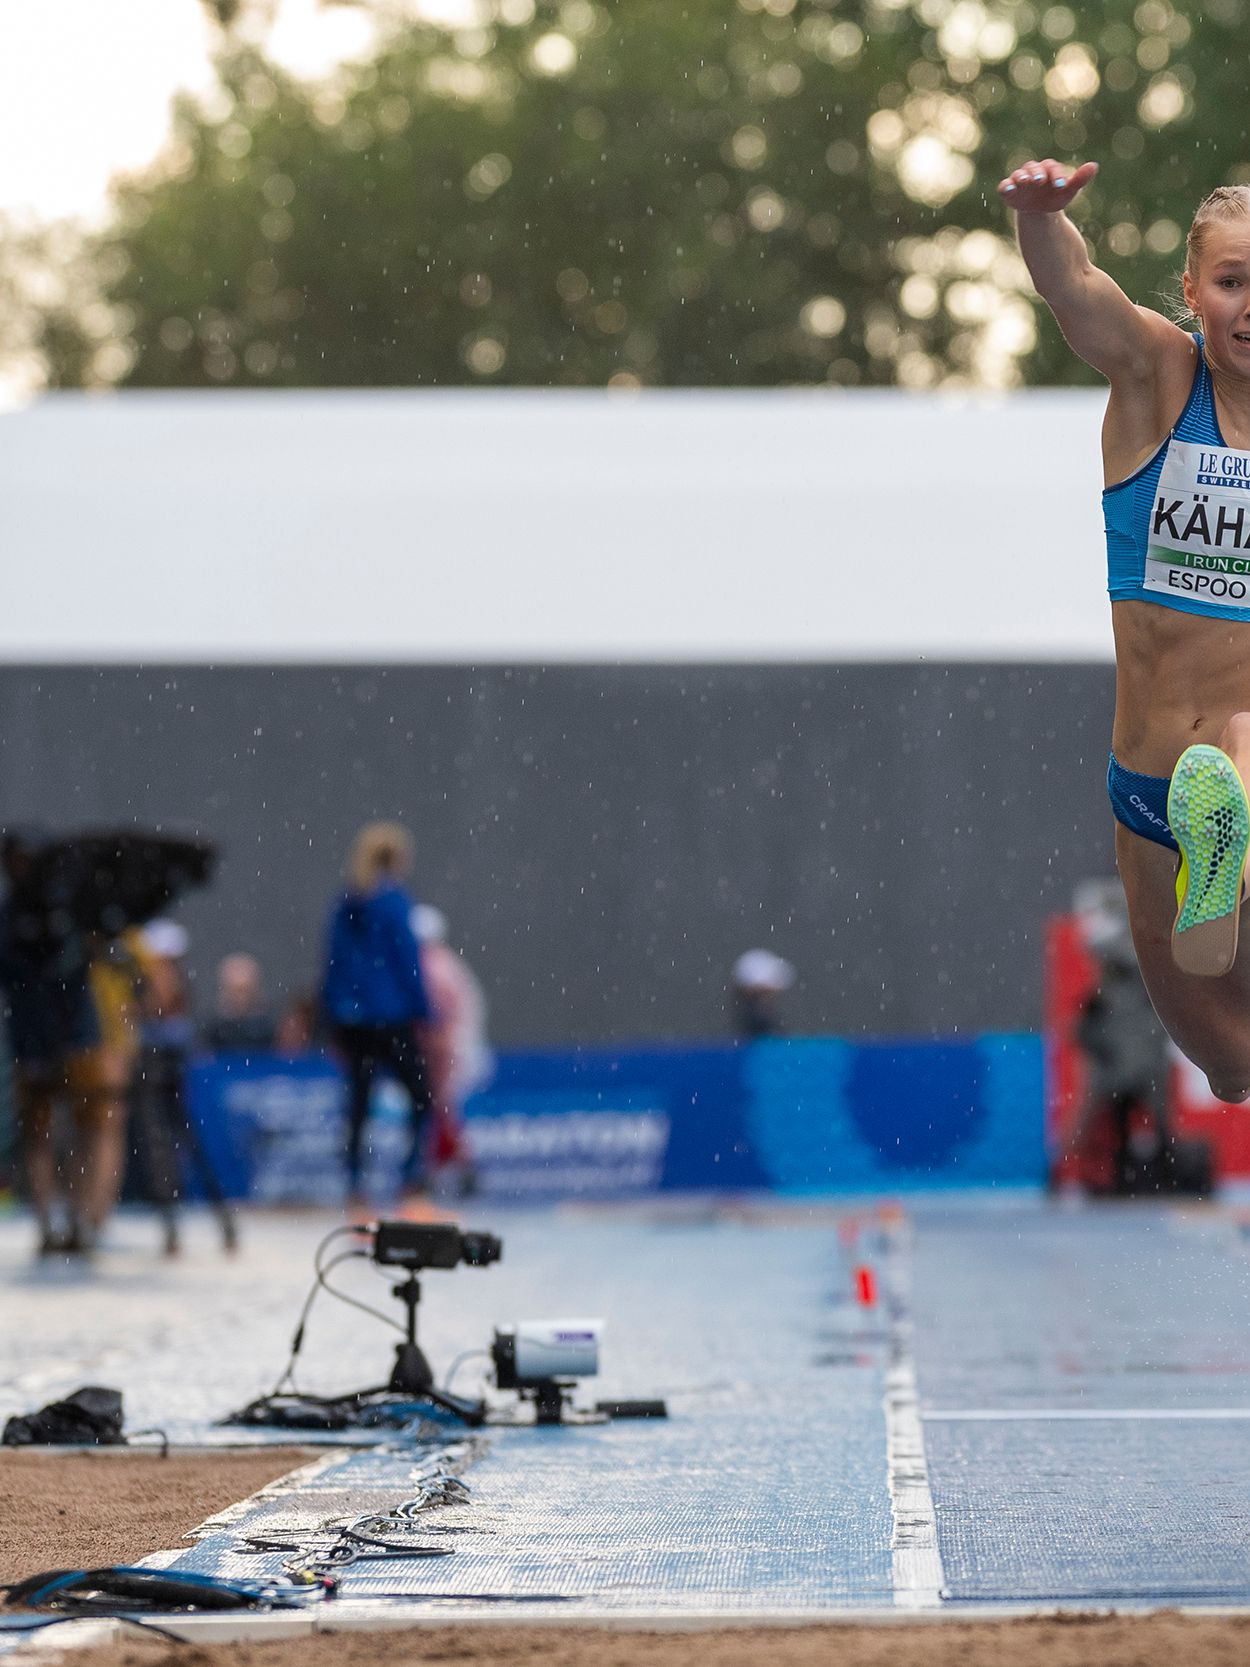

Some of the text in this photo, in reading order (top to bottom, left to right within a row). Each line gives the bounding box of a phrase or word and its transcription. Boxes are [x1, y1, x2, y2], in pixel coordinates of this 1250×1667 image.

[1198, 453, 1218, 473] LE
[1184, 554, 1189, 565] I
[1193, 556, 1230, 572] RUN
[1168, 569, 1247, 599] ESPOO
